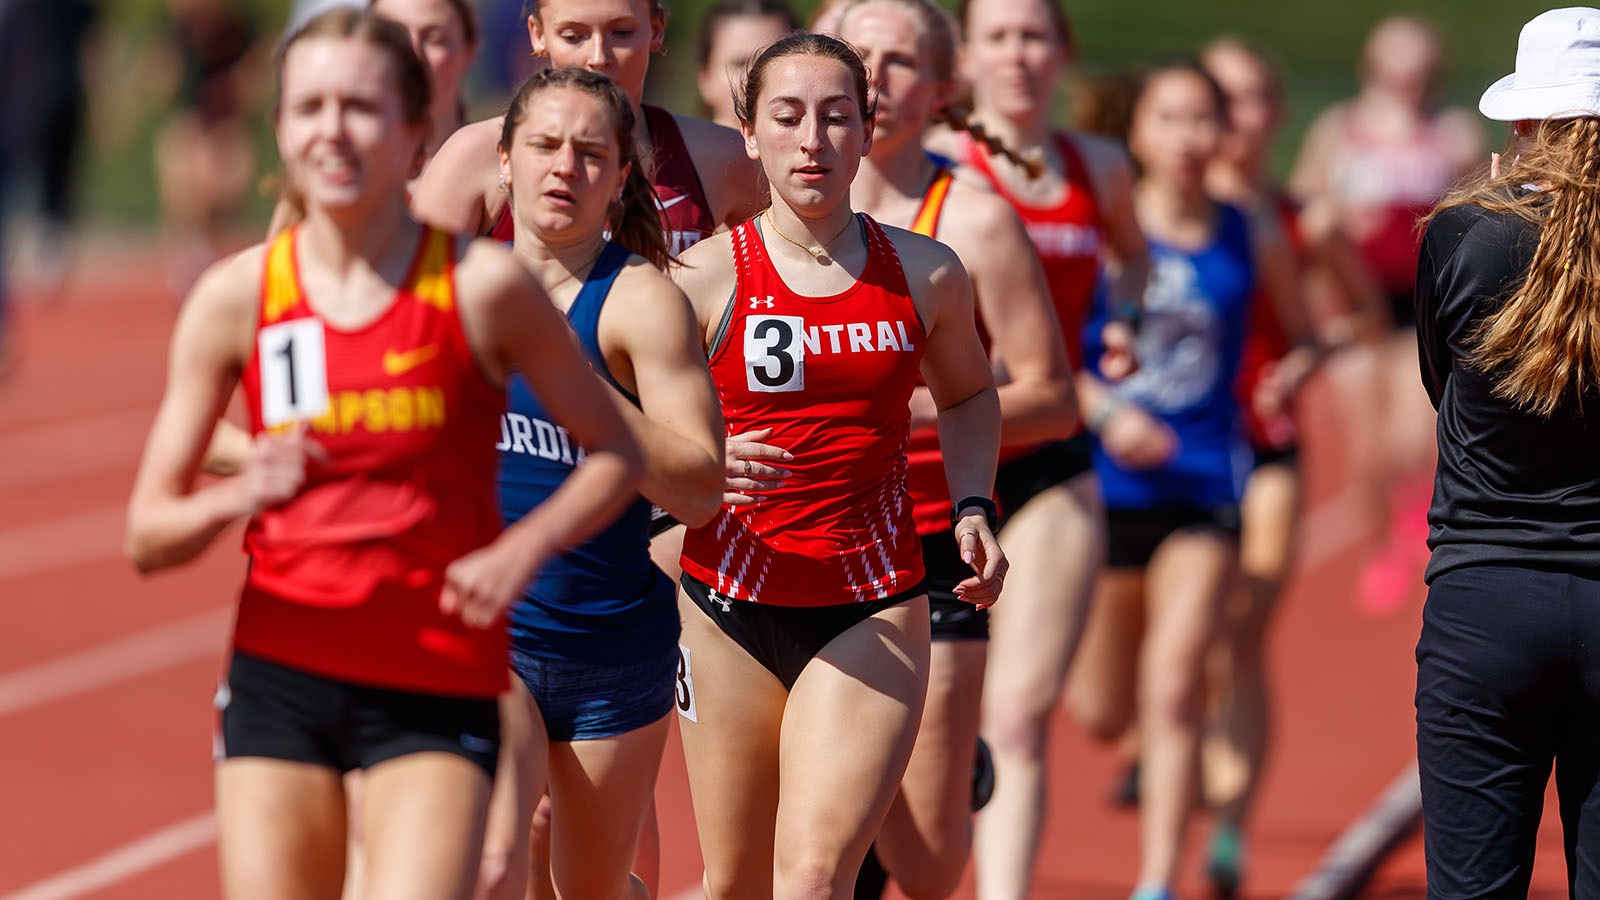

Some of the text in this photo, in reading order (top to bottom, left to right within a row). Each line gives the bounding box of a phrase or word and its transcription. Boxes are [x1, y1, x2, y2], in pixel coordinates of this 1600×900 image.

[752, 319, 795, 387] 3
[803, 321, 914, 355] NTRAL
[274, 336, 298, 407] 1
[268, 386, 445, 436] PSON
